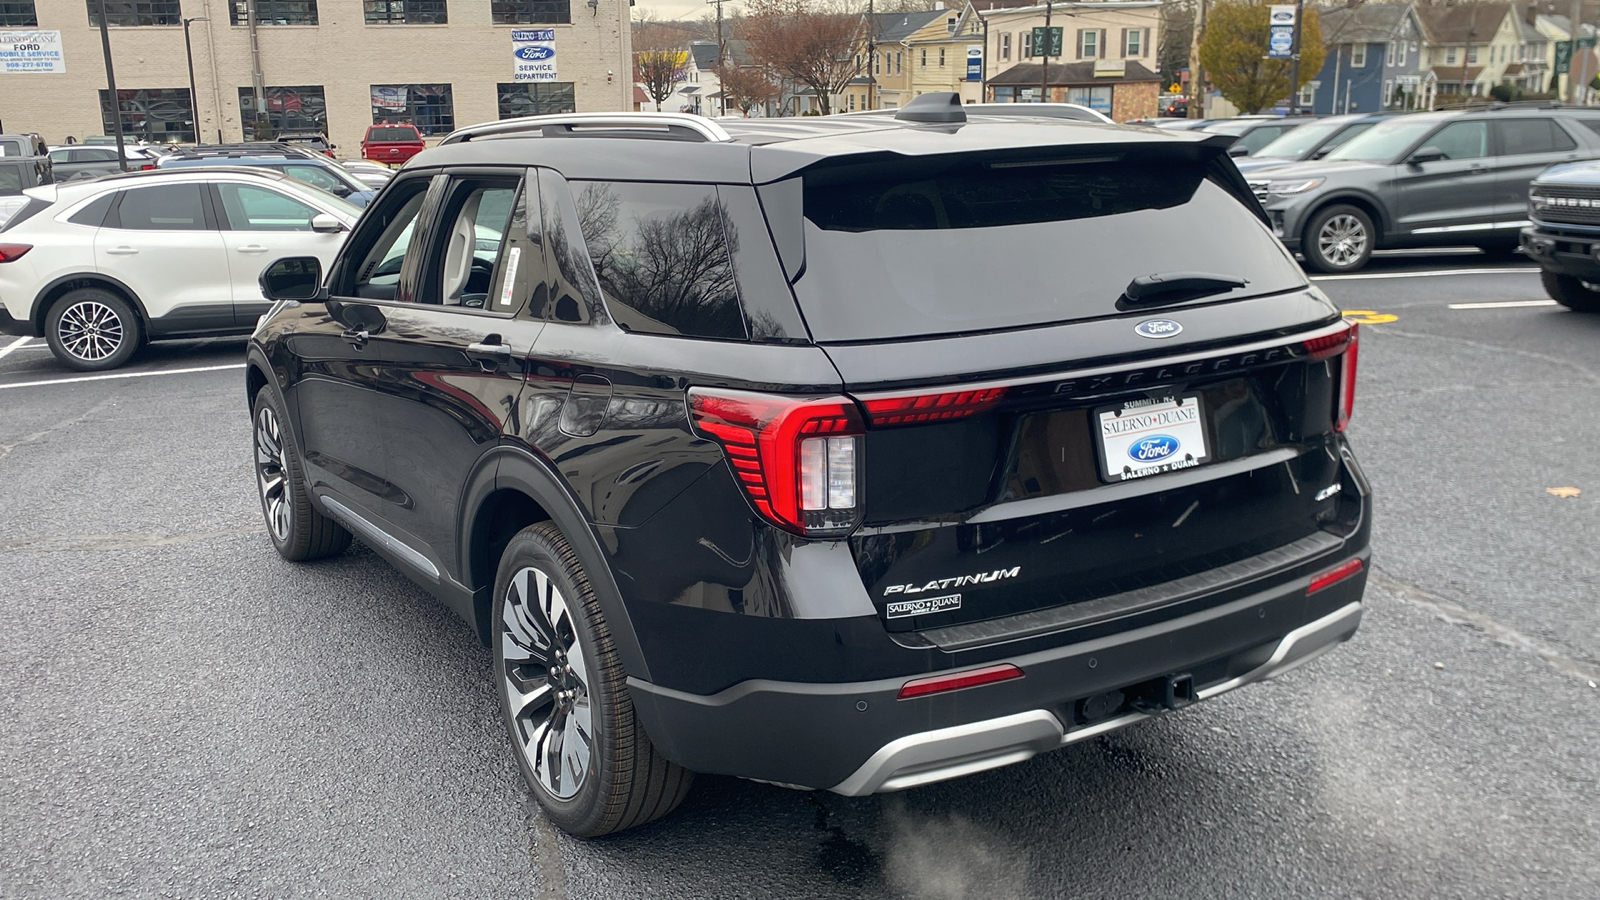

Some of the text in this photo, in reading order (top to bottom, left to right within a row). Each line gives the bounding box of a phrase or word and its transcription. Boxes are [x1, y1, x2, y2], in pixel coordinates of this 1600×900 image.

[13, 43, 41, 51] FORD
[27, 50, 60, 58] SERVICE
[1103, 407, 1196, 436] SALERNO DUANE
[1137, 438, 1171, 460] Ford
[1120, 458, 1199, 481] SALERNO DUANE
[883, 566, 1022, 596] PLATINUM
[889, 596, 959, 614] SALERNO DUANE
